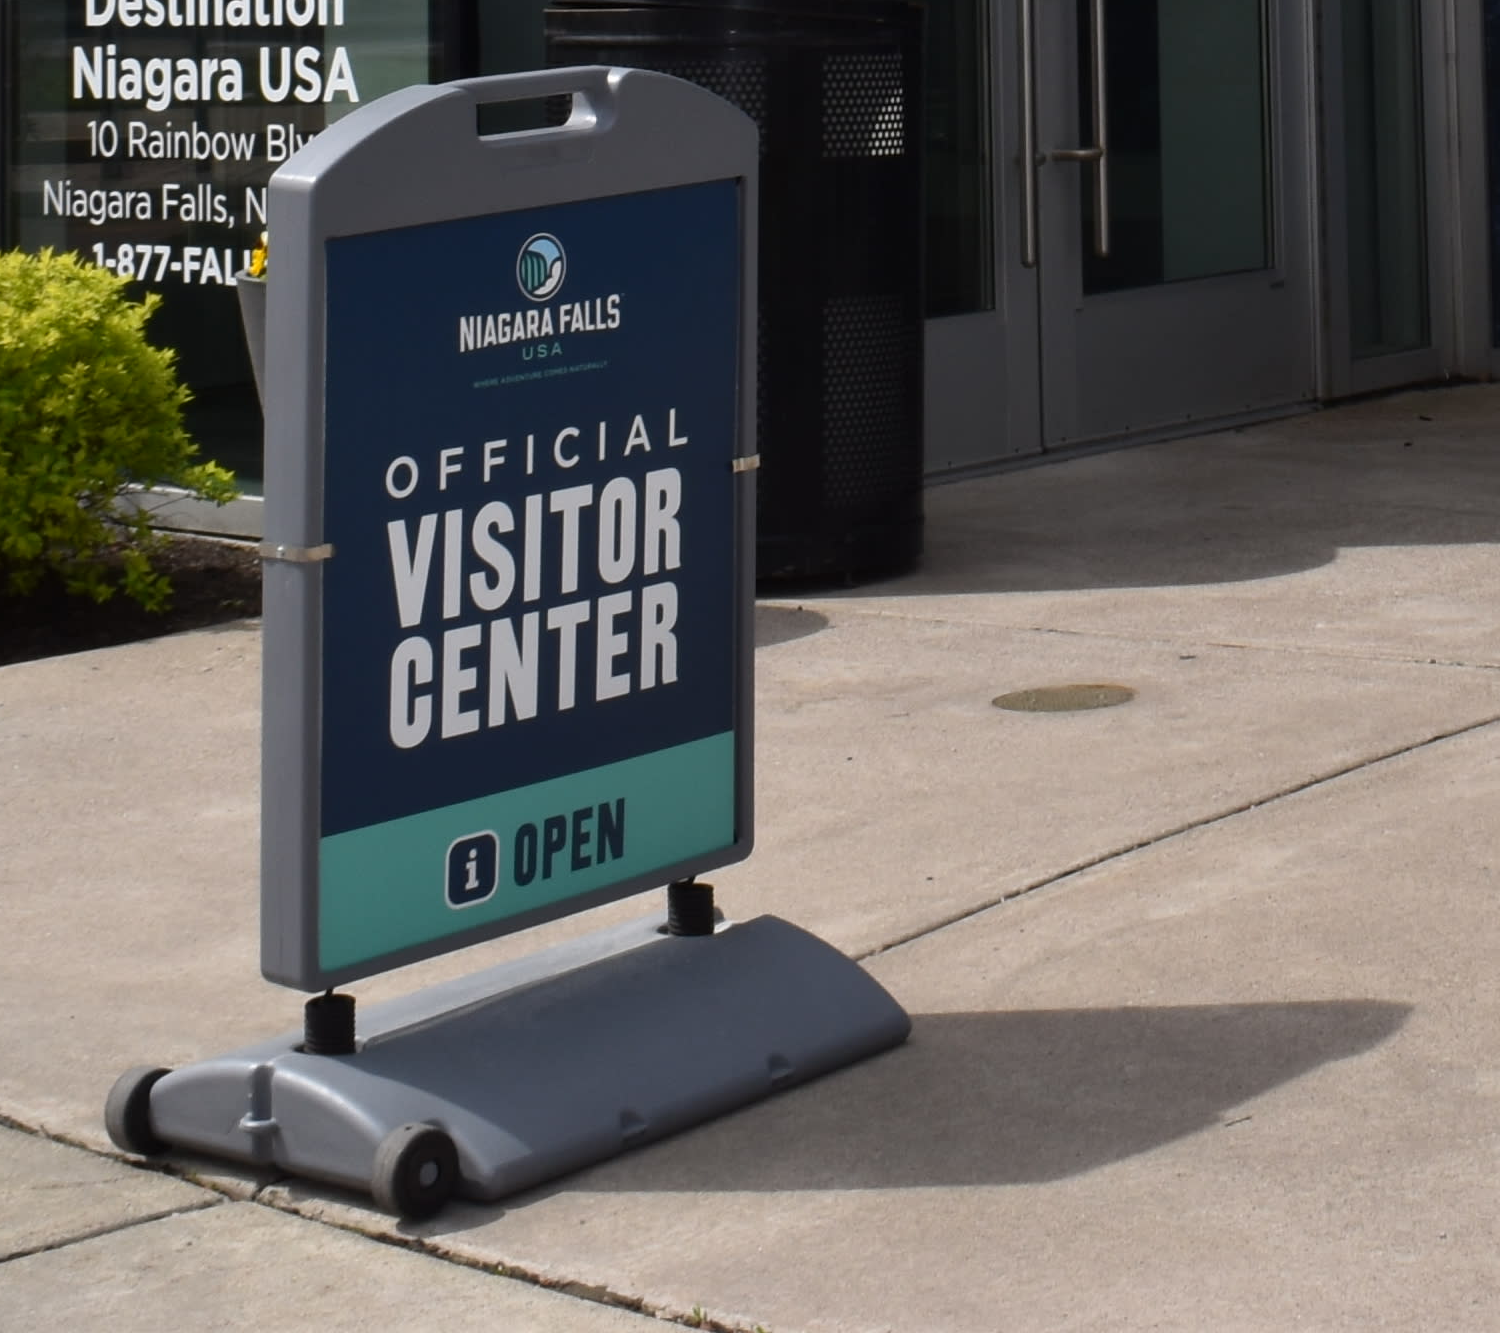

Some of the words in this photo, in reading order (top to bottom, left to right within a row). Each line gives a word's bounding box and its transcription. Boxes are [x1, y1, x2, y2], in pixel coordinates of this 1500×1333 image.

[72, 44, 243, 111] Niagara
[259, 45, 361, 103] USA
[87, 119, 118, 158] 10
[128, 121, 255, 161] Rainbow
[43, 179, 151, 225] Niagara
[162, 183, 235, 229] Falls,
[245, 187, 268, 224] N
[459, 307, 554, 353] NIAGARA
[559, 294, 621, 334] FALLS
[522, 342, 563, 361] USA
[384, 407, 689, 499] OFFICIAL
[386, 466, 682, 629] VISITOR
[389, 581, 679, 749] CENTER
[513, 797, 626, 887] OPEN
